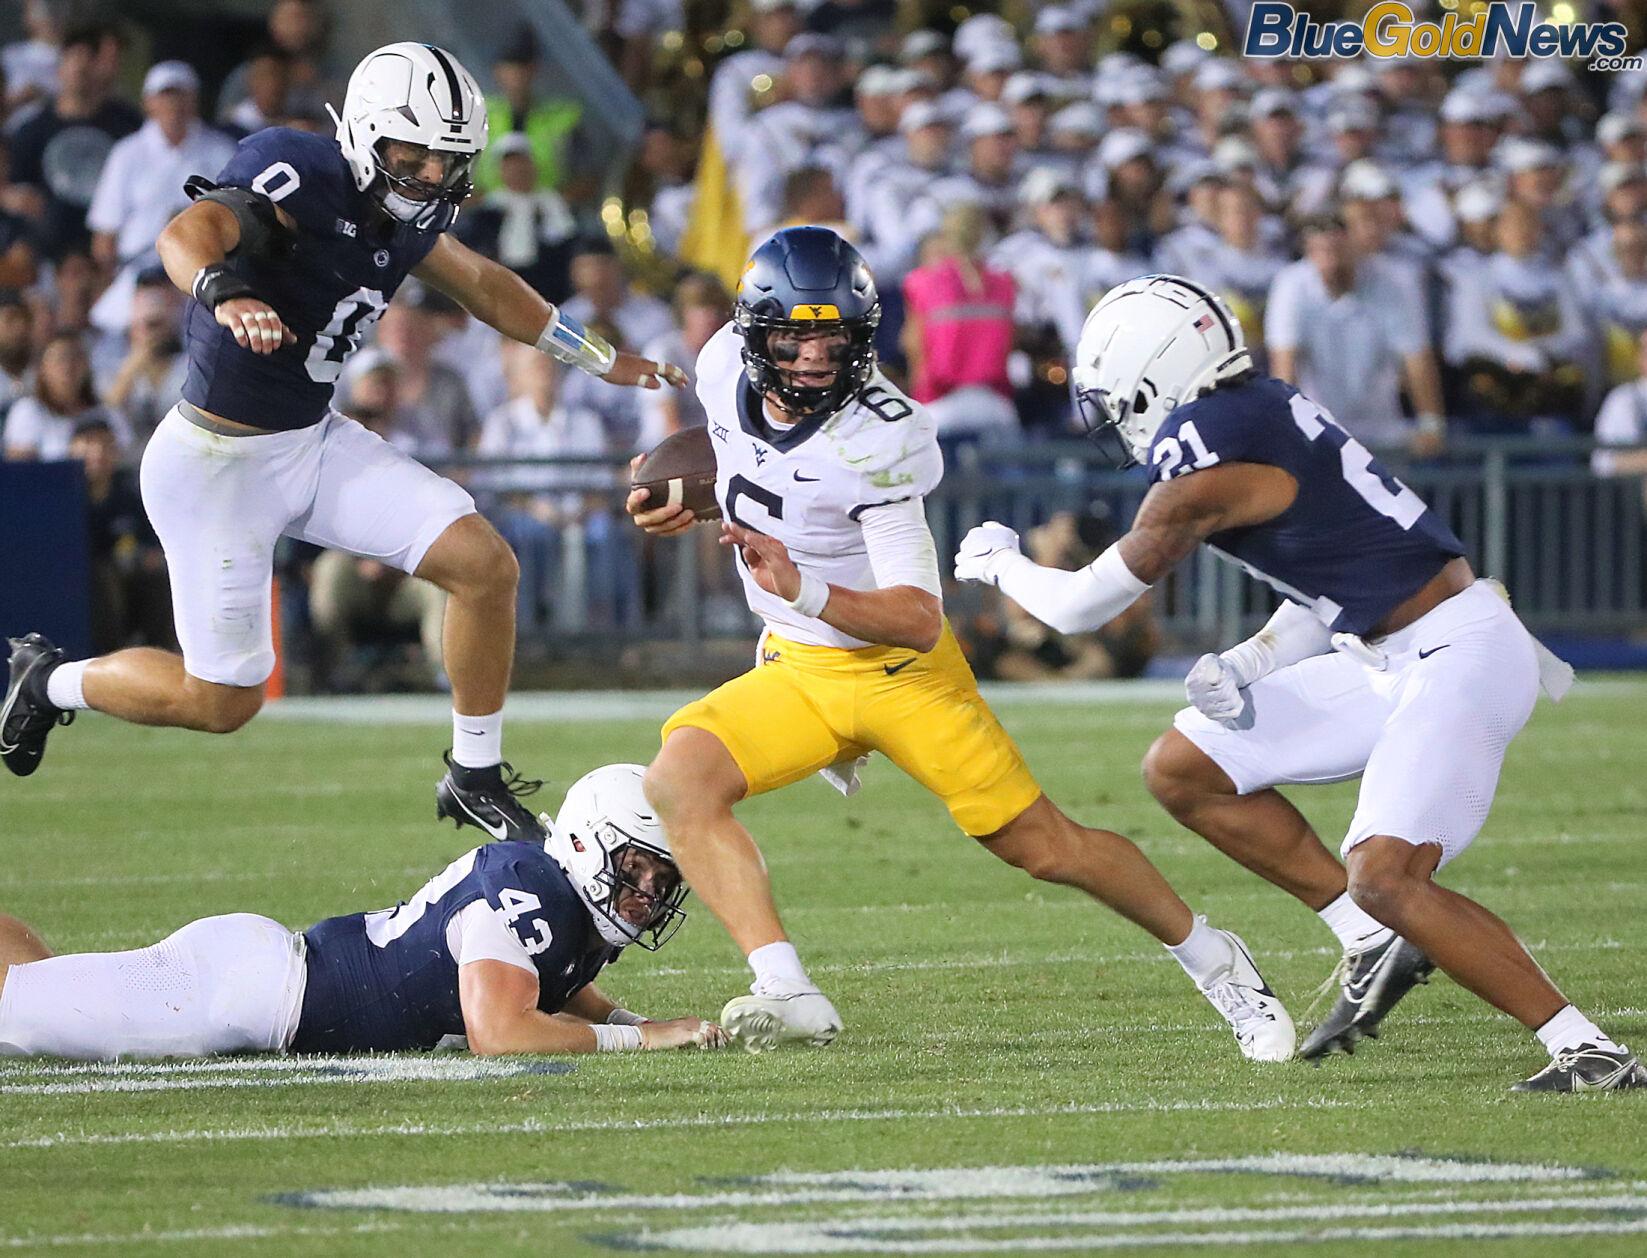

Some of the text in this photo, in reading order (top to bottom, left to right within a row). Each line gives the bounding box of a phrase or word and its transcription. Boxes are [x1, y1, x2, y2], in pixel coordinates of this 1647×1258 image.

[251, 161, 301, 203] 0
[859, 386, 913, 422] 6
[1152, 420, 1220, 482] 21
[498, 887, 553, 956] 43
